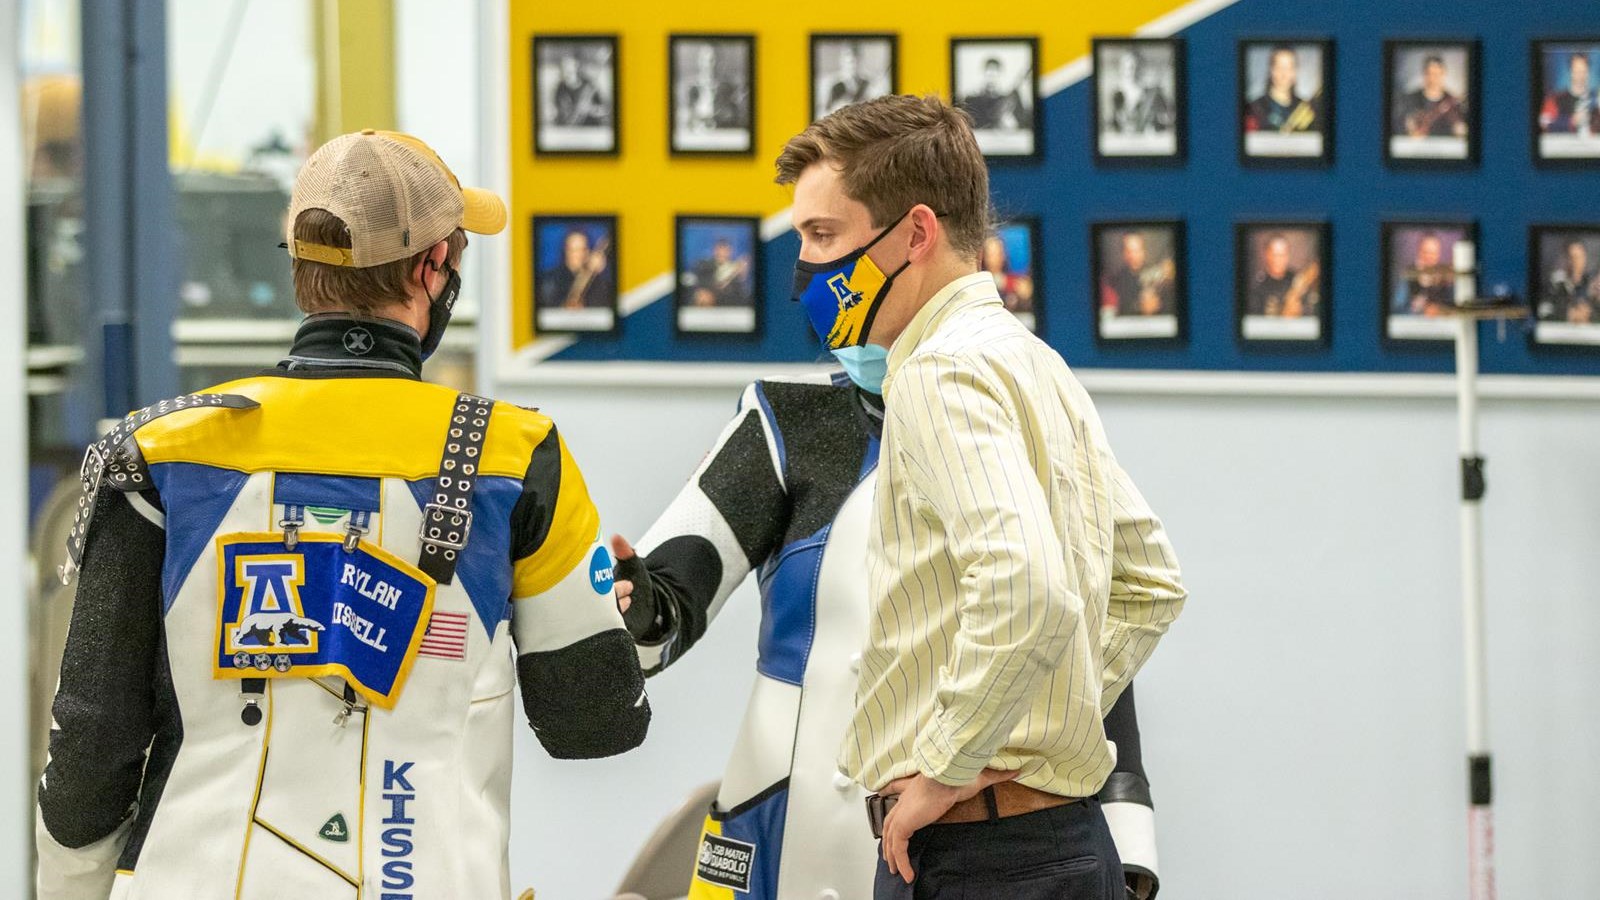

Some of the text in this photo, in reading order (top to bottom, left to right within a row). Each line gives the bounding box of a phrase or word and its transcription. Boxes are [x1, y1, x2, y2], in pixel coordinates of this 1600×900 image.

[341, 563, 402, 610] RYLAN
[595, 567, 614, 583] NCAA
[225, 553, 318, 654] A
[381, 760, 415, 900] KISS
[710, 855, 747, 874] DIABOLO
[712, 844, 750, 862] JSB MATCH
